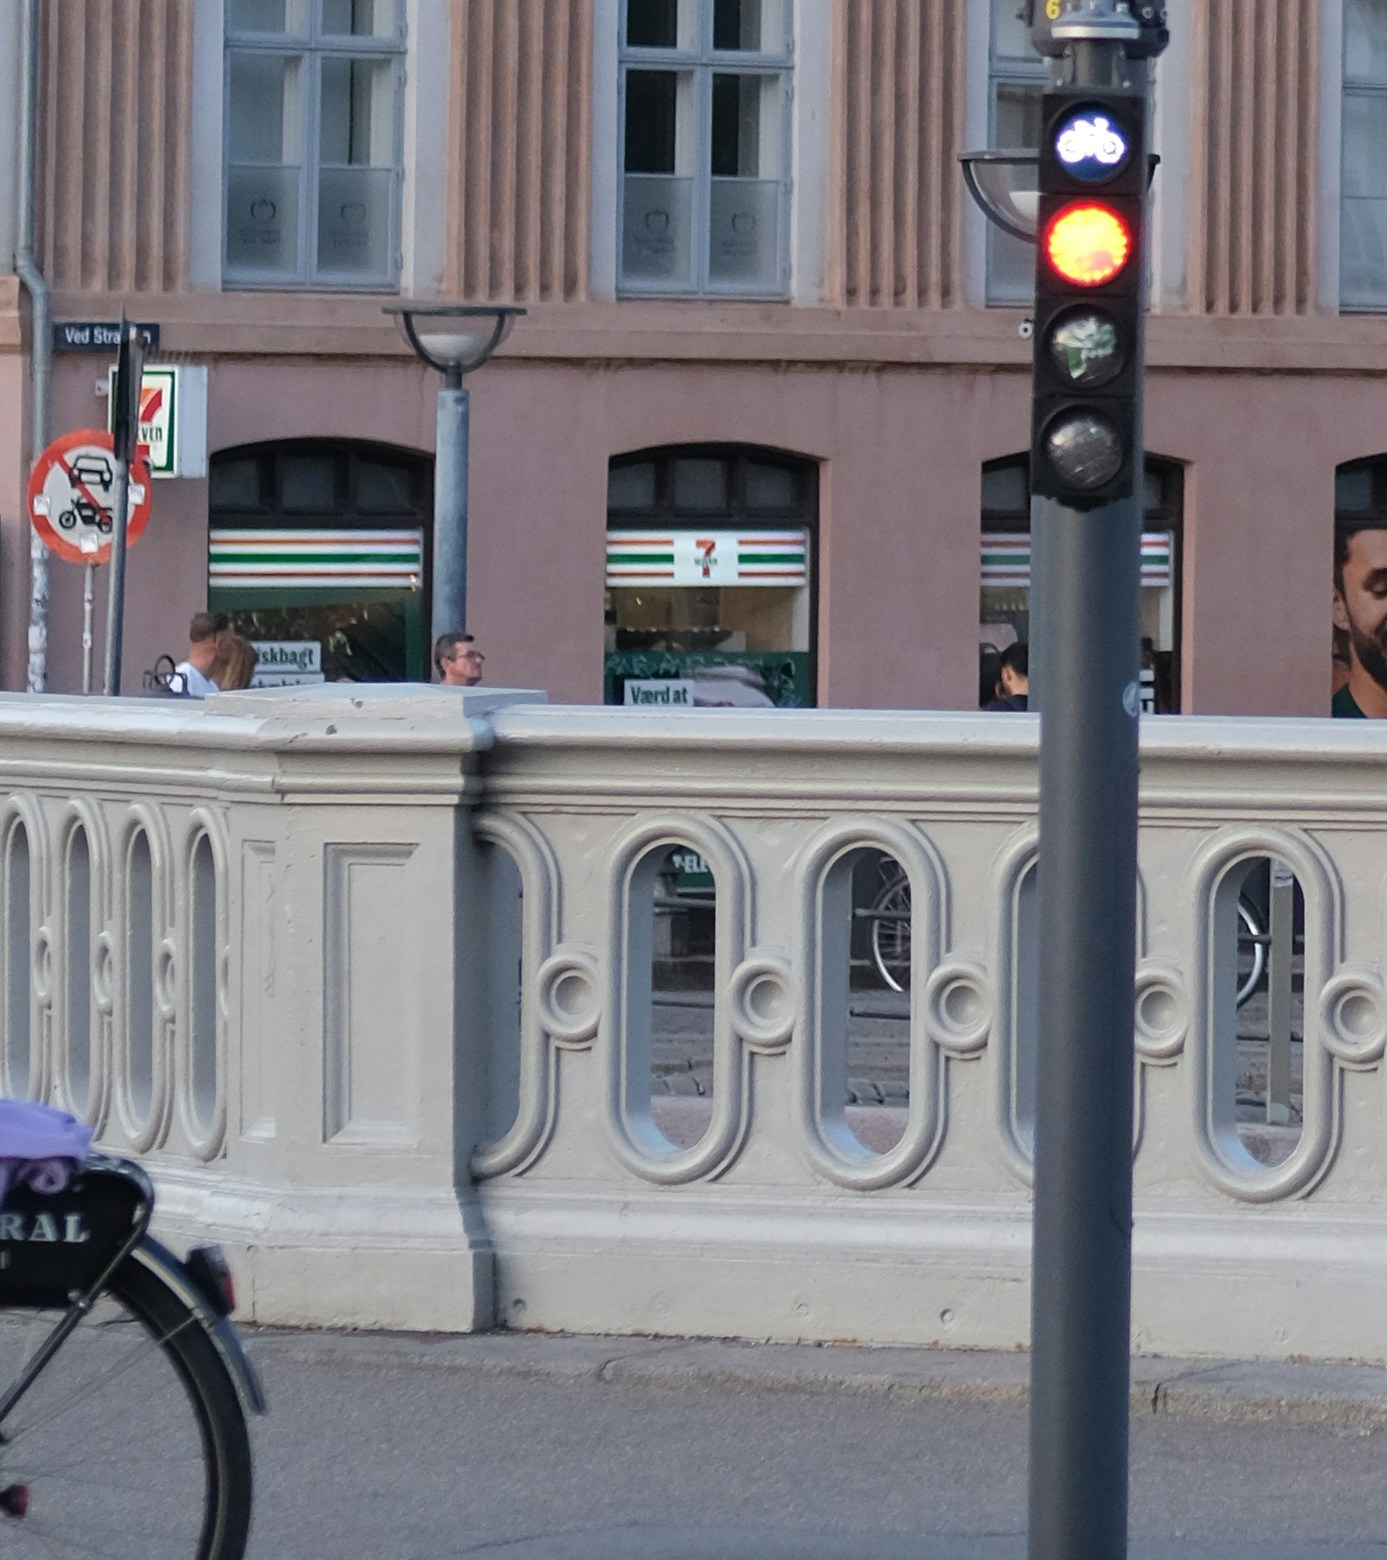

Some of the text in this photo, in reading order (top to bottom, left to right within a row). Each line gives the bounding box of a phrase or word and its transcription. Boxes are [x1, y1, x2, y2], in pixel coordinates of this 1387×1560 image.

[65, 326, 90, 345] Ved
[631, 686, 689, 705] Værd at
